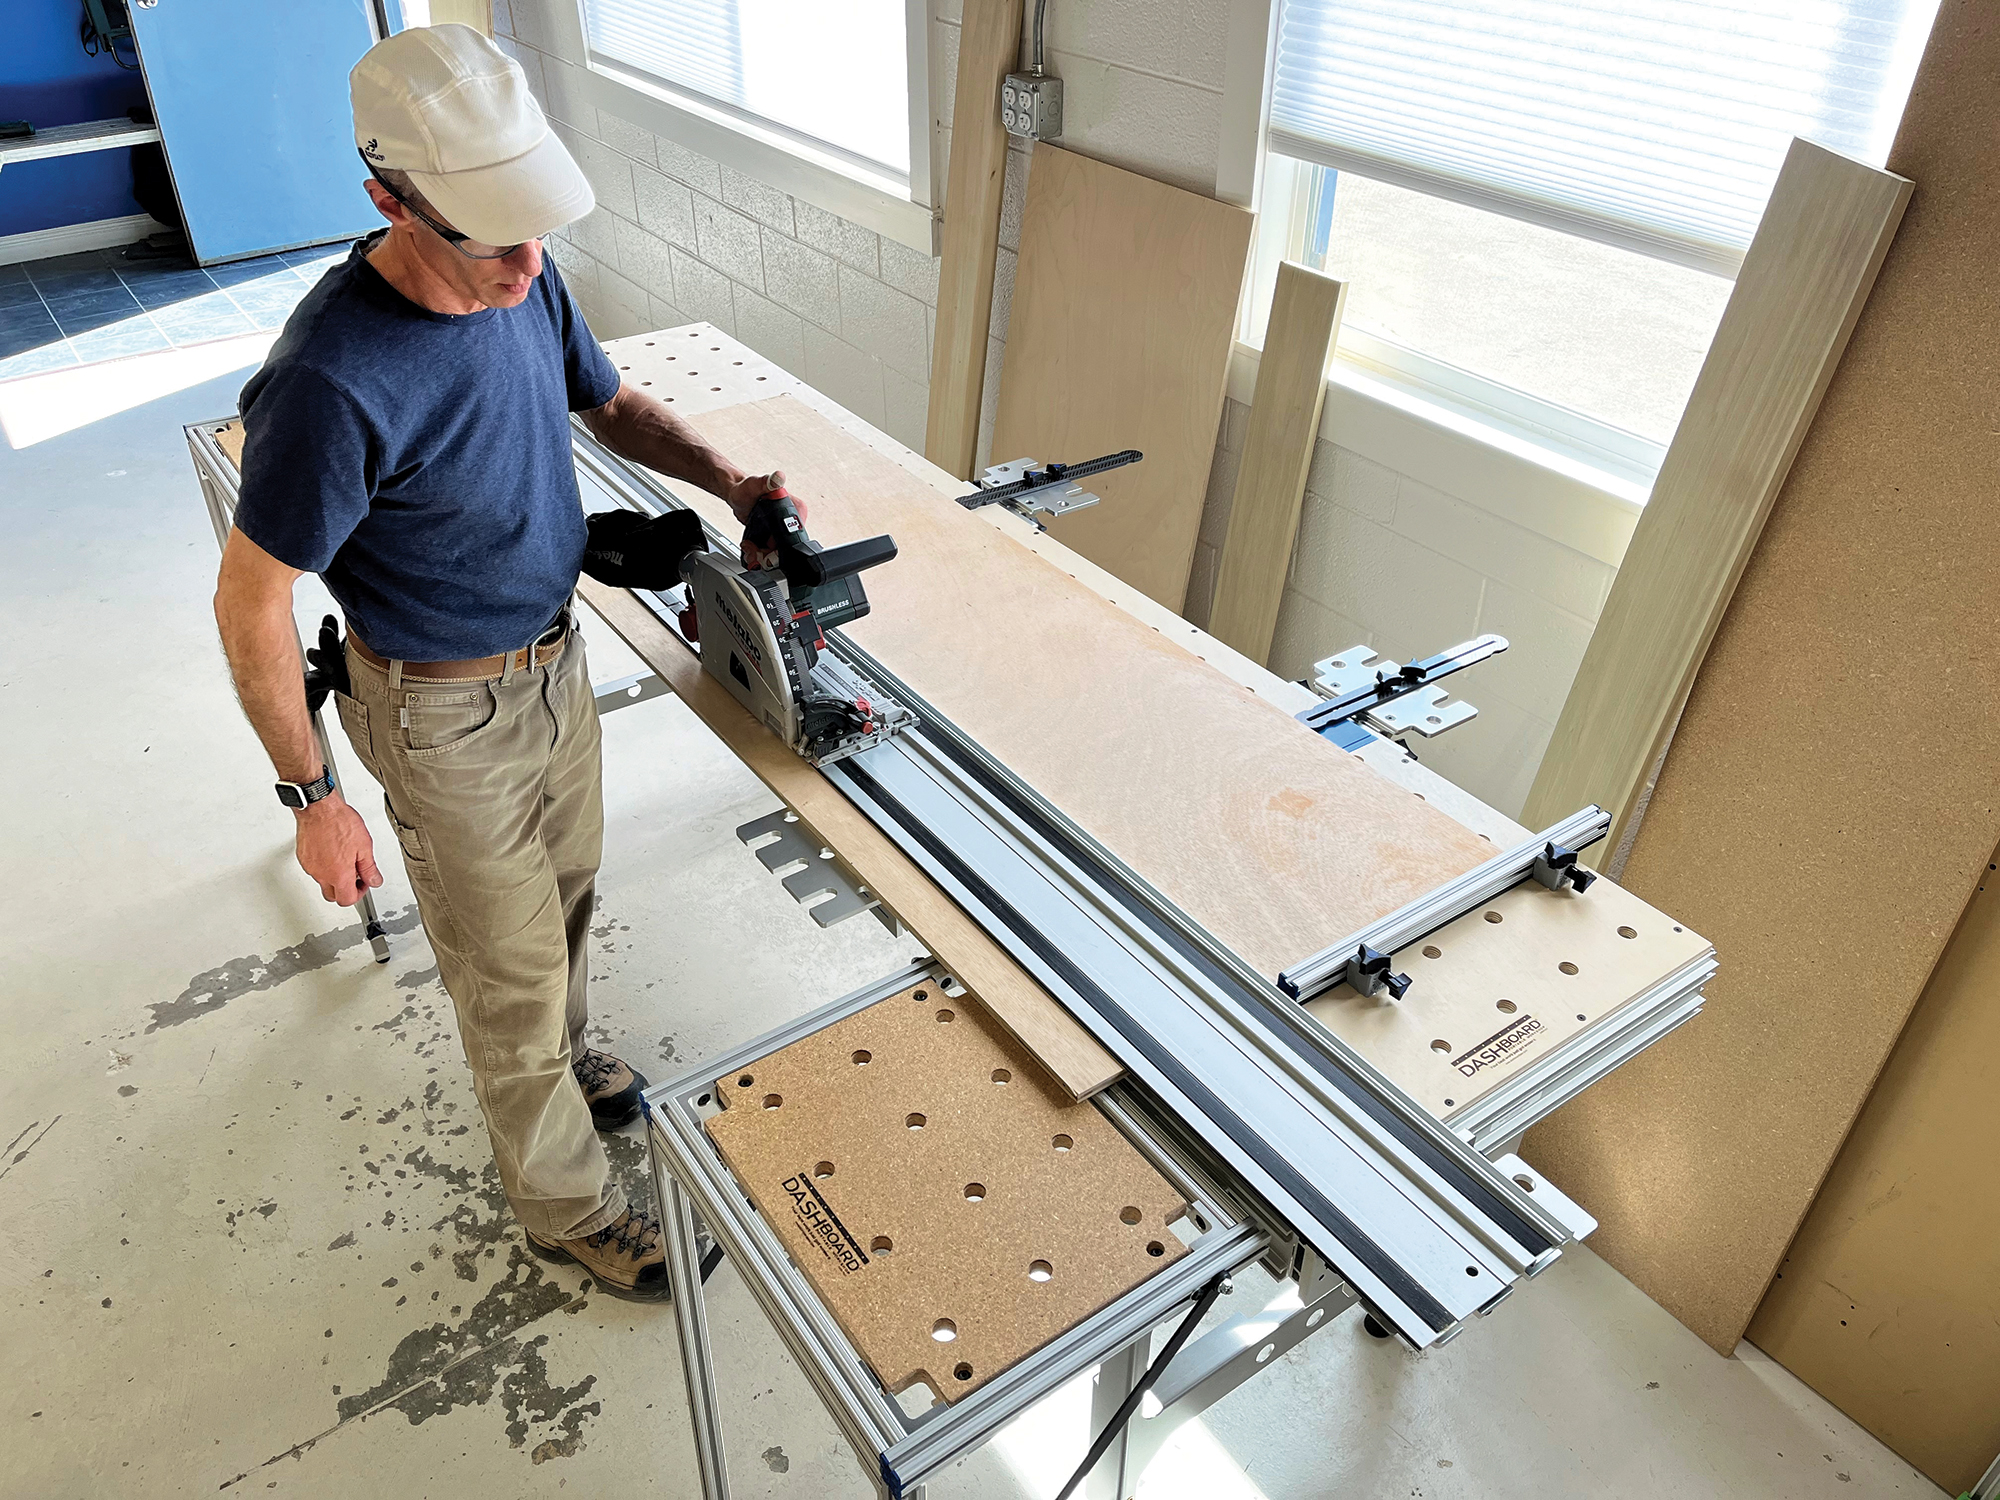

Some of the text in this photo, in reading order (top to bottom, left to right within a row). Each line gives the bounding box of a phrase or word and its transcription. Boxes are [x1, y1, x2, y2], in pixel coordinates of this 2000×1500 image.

[715, 591, 762, 661] metabo
[817, 599, 849, 615] BRUSHLESS
[1458, 1020, 1541, 1078] DASHBOARD
[782, 1177, 860, 1272] DASHBOARD
